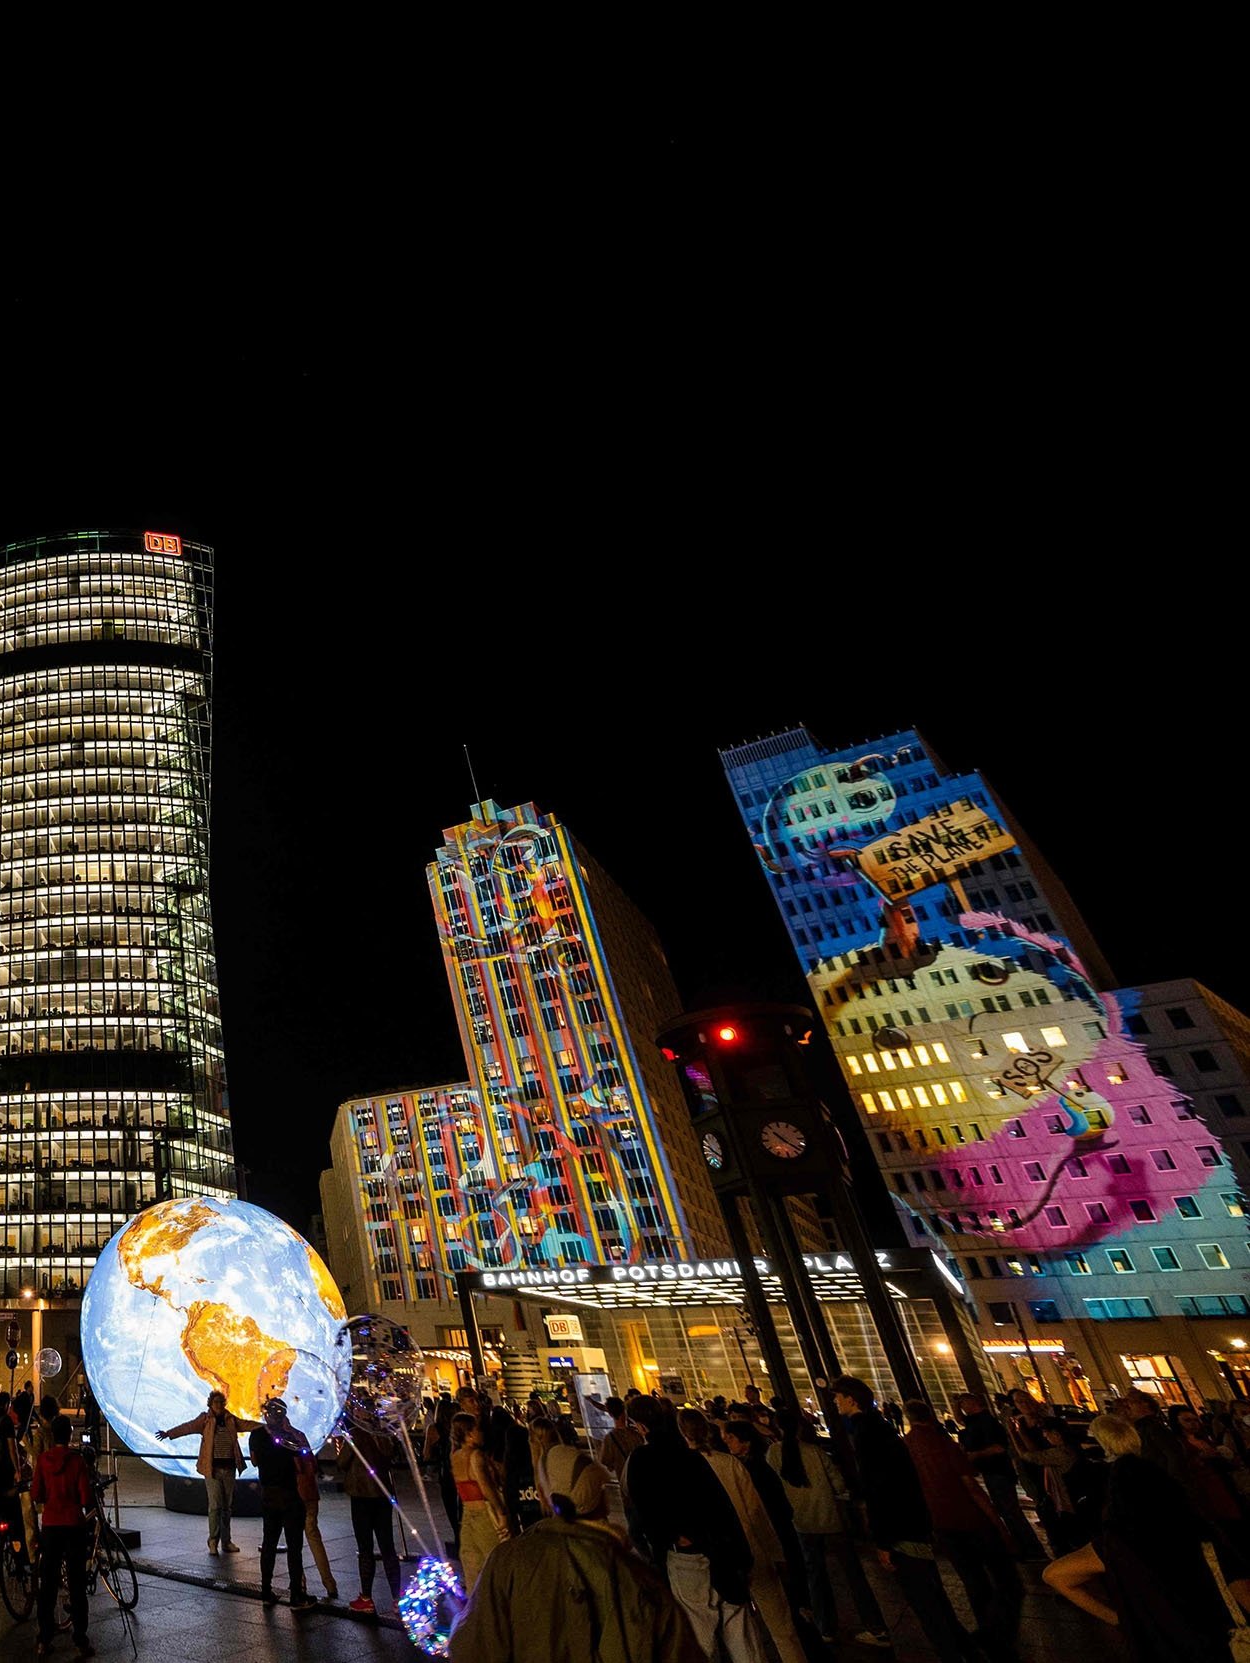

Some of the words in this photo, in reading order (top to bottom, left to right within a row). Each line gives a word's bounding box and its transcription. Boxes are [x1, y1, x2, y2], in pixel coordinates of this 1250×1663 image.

[148, 534, 178, 553] DB
[888, 859, 922, 879] THE
[919, 824, 992, 871] PLANET
[889, 819, 961, 859] SAVE
[483, 1268, 590, 1287] BAHNHOF
[612, 1260, 769, 1281] POTSDAMR
[803, 1252, 891, 1271] PLAZ
[551, 1321, 568, 1333] DB
